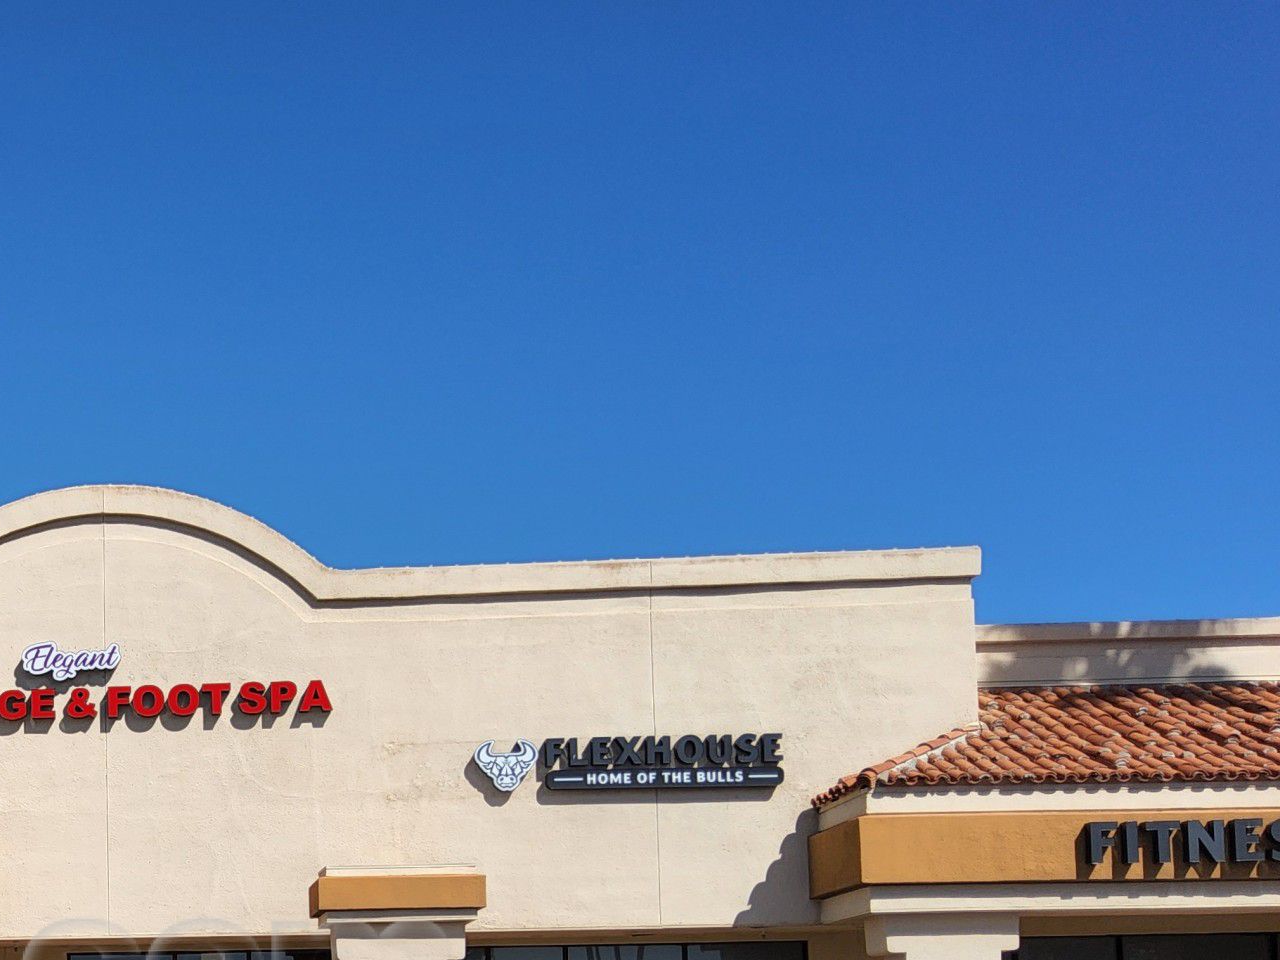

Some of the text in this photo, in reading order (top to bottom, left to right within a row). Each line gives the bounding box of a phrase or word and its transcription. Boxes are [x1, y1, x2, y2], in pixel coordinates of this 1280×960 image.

[22, 643, 120, 680] Elegant
[67, 686, 98, 720] &
[107, 682, 231, 719] FOOT
[238, 680, 333, 714] SPA
[544, 733, 784, 768] FLEXHOUSE
[586, 771, 744, 785] HOME OF THE BULLS
